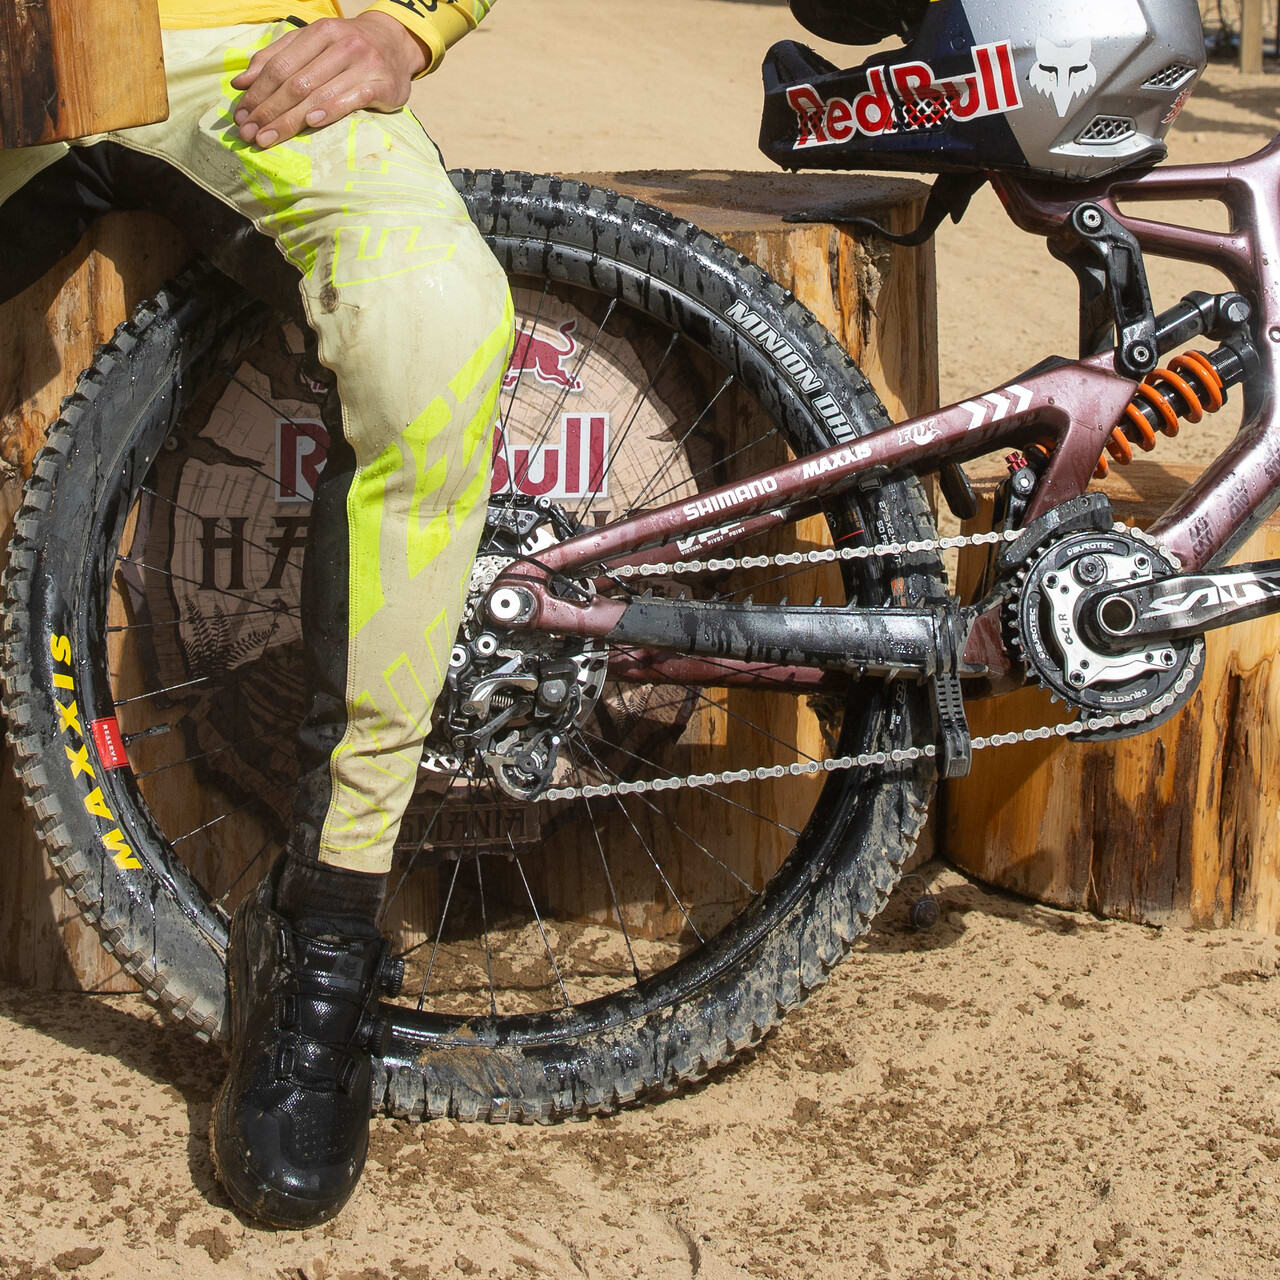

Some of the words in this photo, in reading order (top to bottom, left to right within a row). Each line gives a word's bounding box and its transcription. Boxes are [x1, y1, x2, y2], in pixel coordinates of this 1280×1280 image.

[787, 66, 897, 147] Red
[890, 42, 1021, 129] Bull
[725, 300, 824, 394] MINION
[682, 476, 778, 521] SHIMANO
[802, 442, 873, 480] MAXXIS
[897, 419, 942, 447] FOX
[1072, 541, 1114, 555] BURGTEC
[50, 632, 143, 870] MAXXIS
[101, 723, 118, 762] RESERVE
